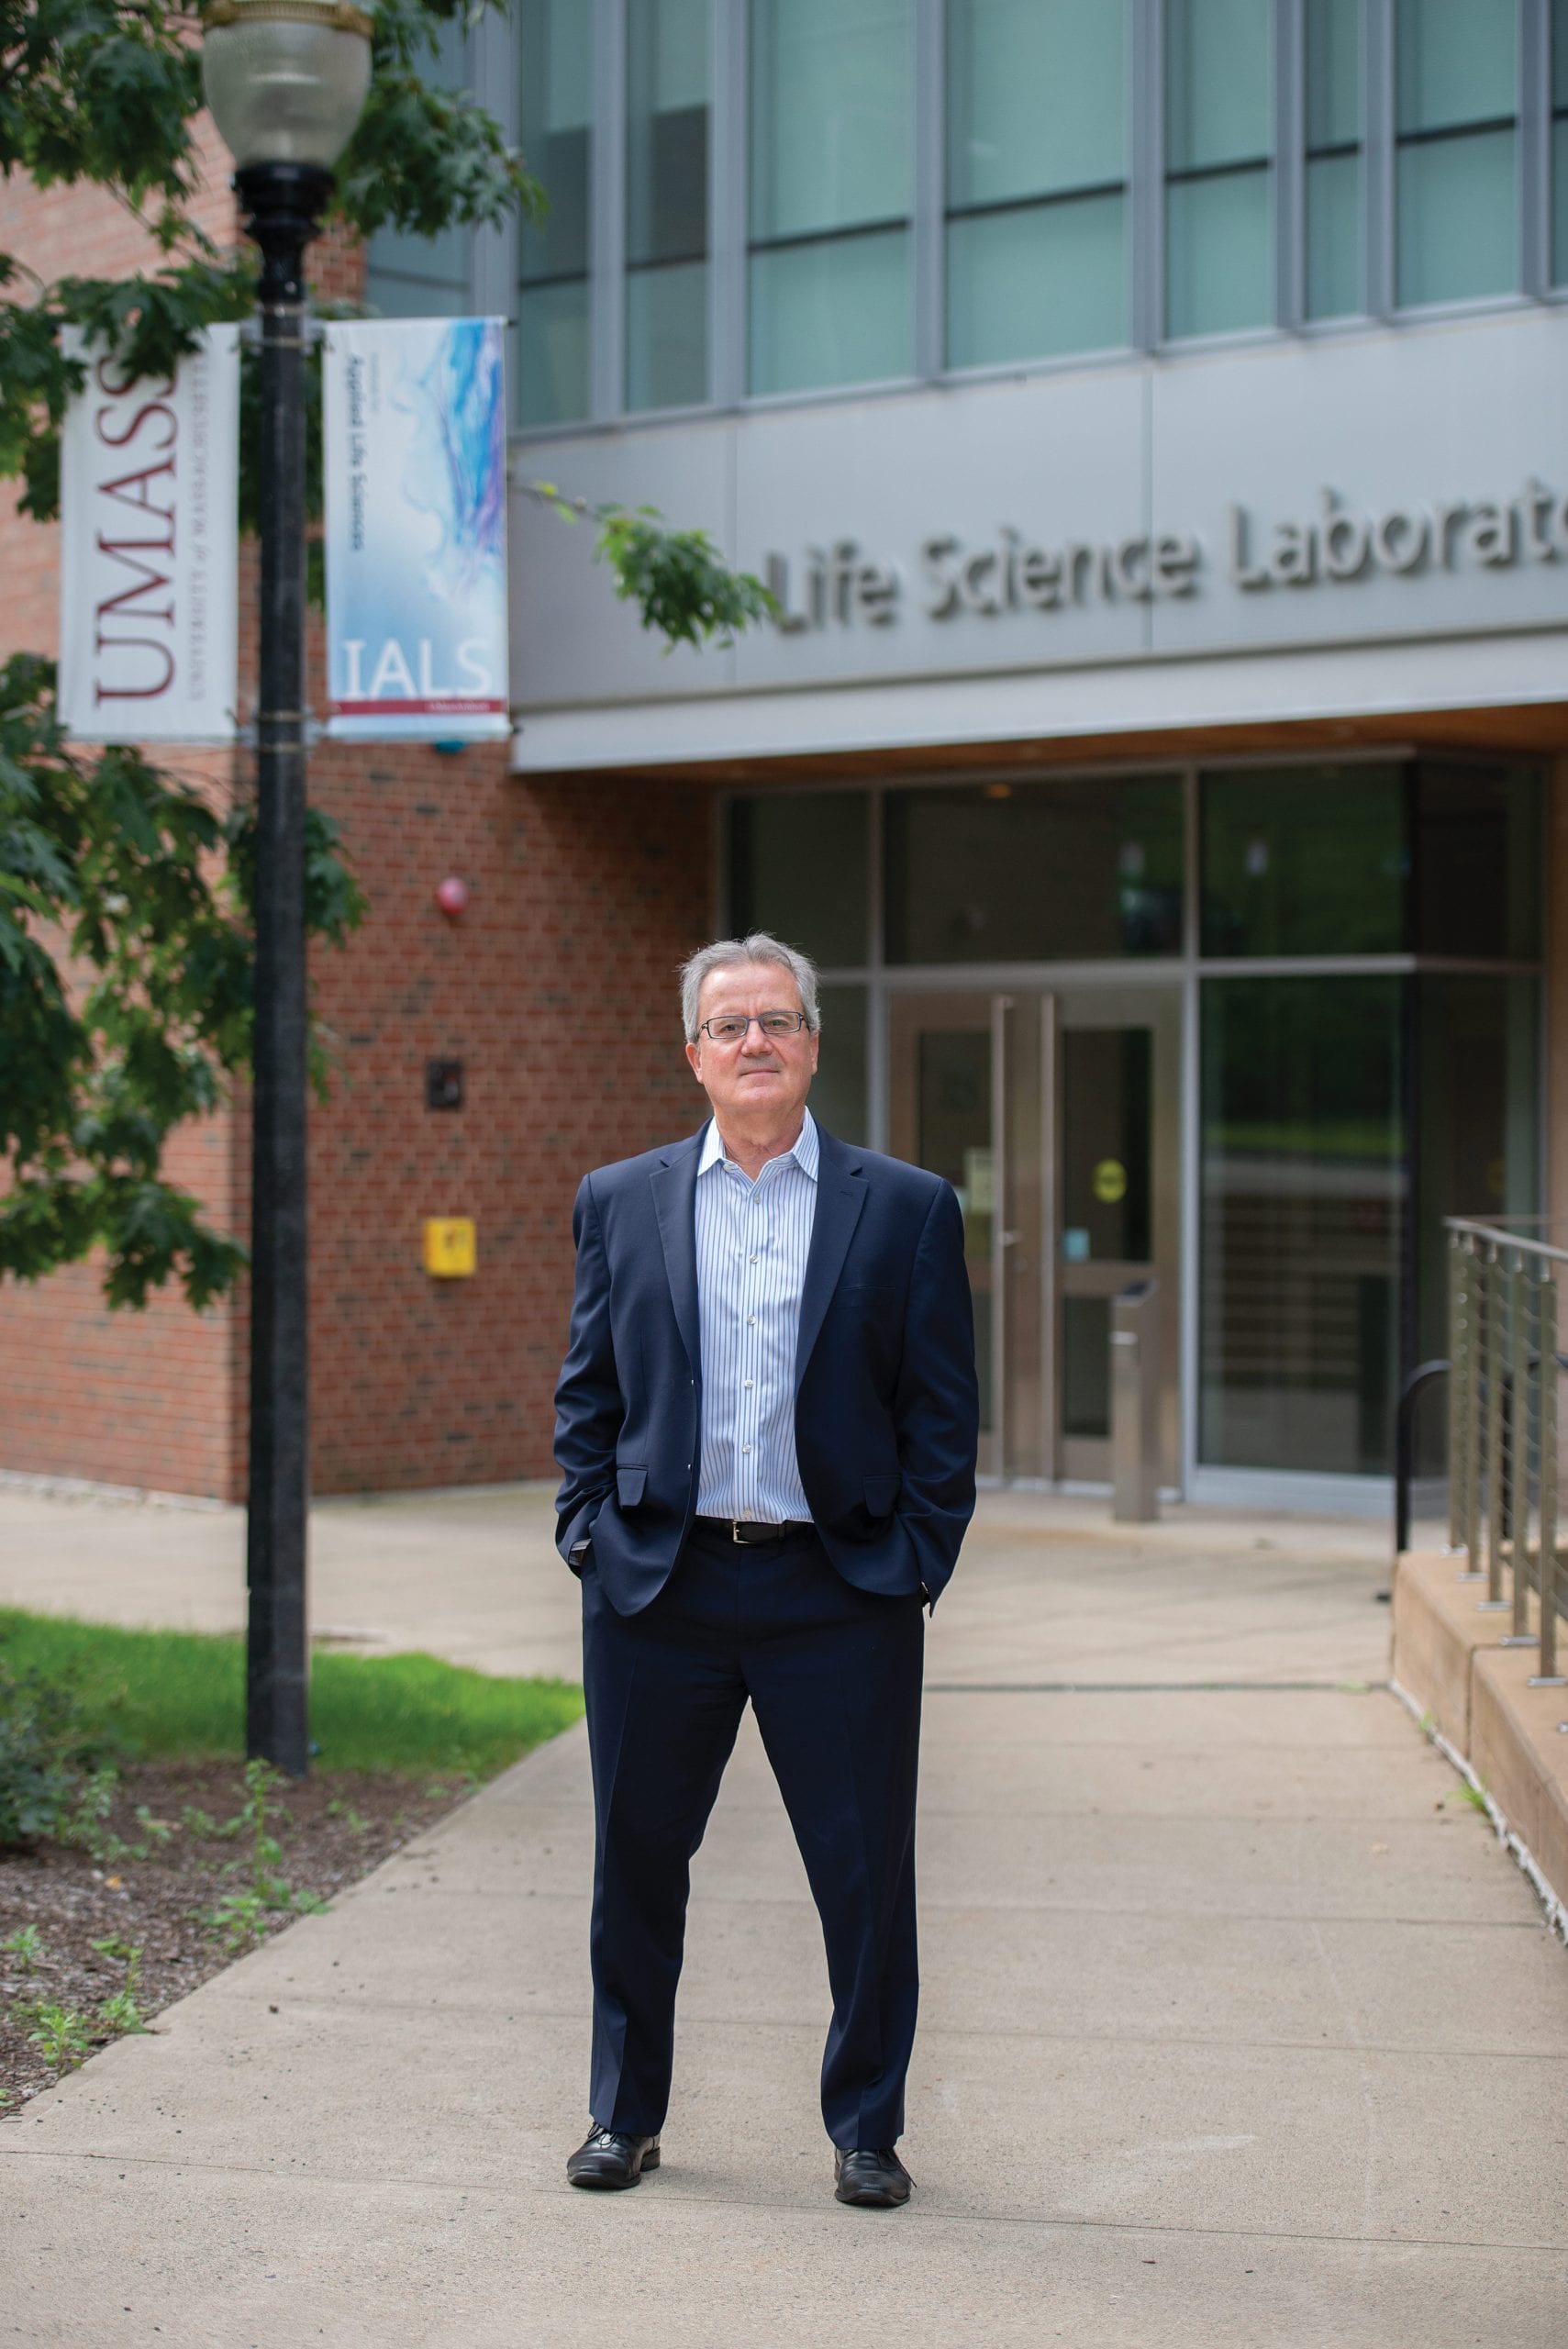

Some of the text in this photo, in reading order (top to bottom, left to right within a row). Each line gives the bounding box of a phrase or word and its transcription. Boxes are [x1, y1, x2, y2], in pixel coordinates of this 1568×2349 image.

[345, 351, 367, 551] Applied Life Sciences
[765, 537, 901, 634] Life
[919, 525, 1201, 622] Science
[342, 637, 494, 700] IALS
